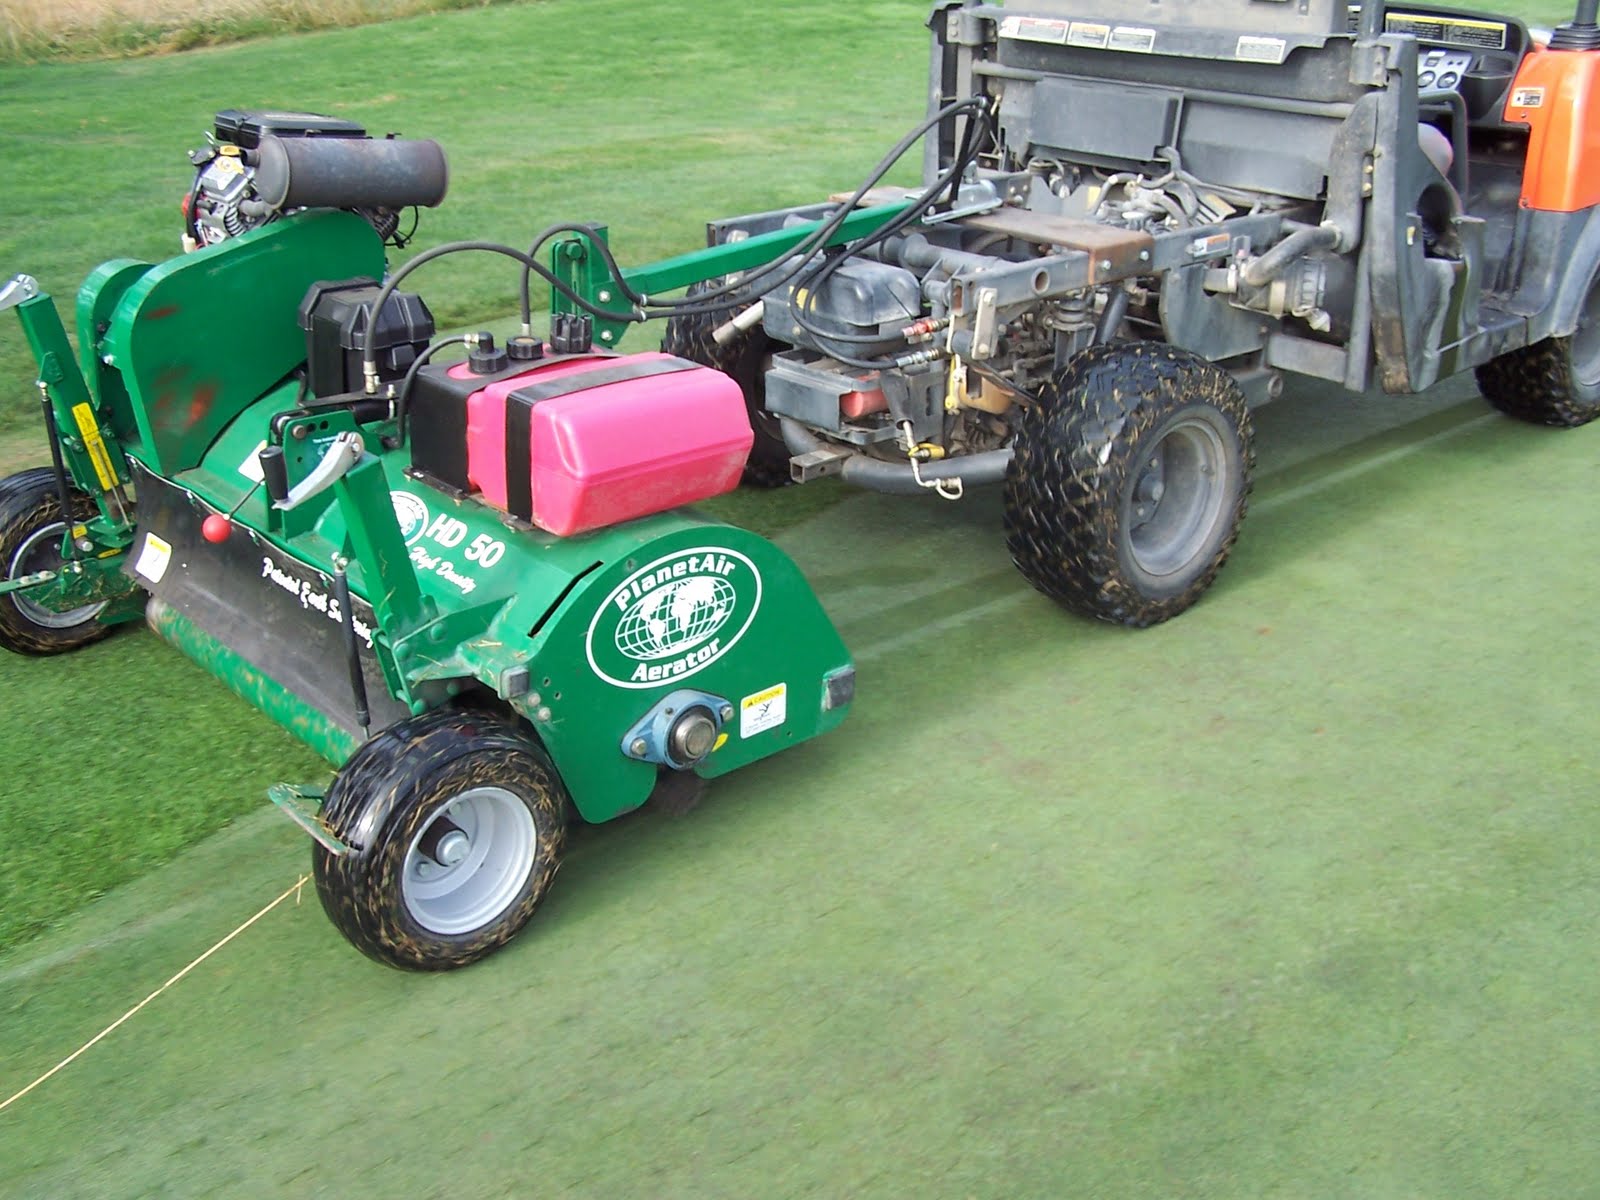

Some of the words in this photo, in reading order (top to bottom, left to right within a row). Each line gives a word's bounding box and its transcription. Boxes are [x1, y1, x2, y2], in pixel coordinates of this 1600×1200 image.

[425, 513, 468, 548] HD
[464, 534, 506, 568] 50
[409, 546, 442, 570] High
[436, 561, 477, 595] Density
[614, 553, 736, 612] PlanetAir
[630, 638, 721, 682] Aerator
